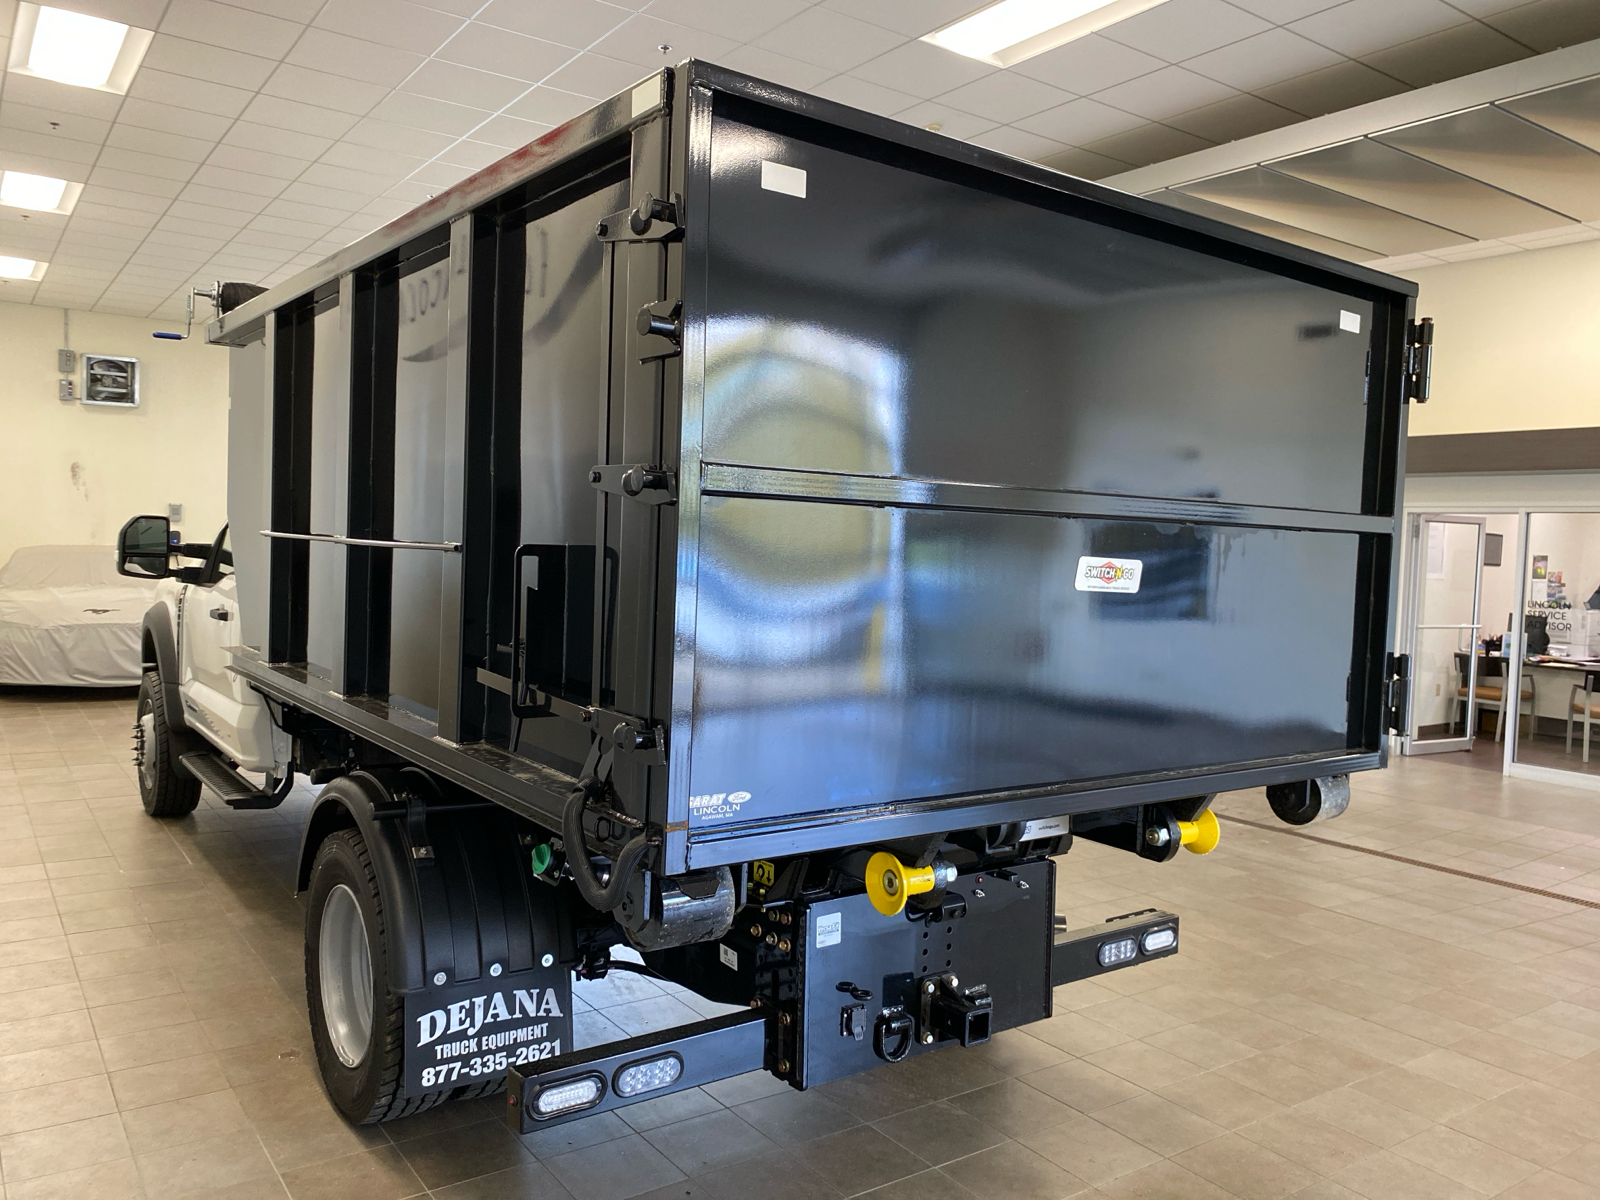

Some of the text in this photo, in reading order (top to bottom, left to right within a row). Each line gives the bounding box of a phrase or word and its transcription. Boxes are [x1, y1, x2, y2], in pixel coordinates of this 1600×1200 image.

[1527, 600, 1572, 610] LINCOLN
[1527, 610, 1567, 620] SERVICE
[693, 803, 741, 816] LINCOLN
[416, 987, 564, 1048] DEJANA
[434, 1022, 549, 1060] TRUCK EQUIPMENT
[421, 1038, 561, 1087] 877-335-2621
